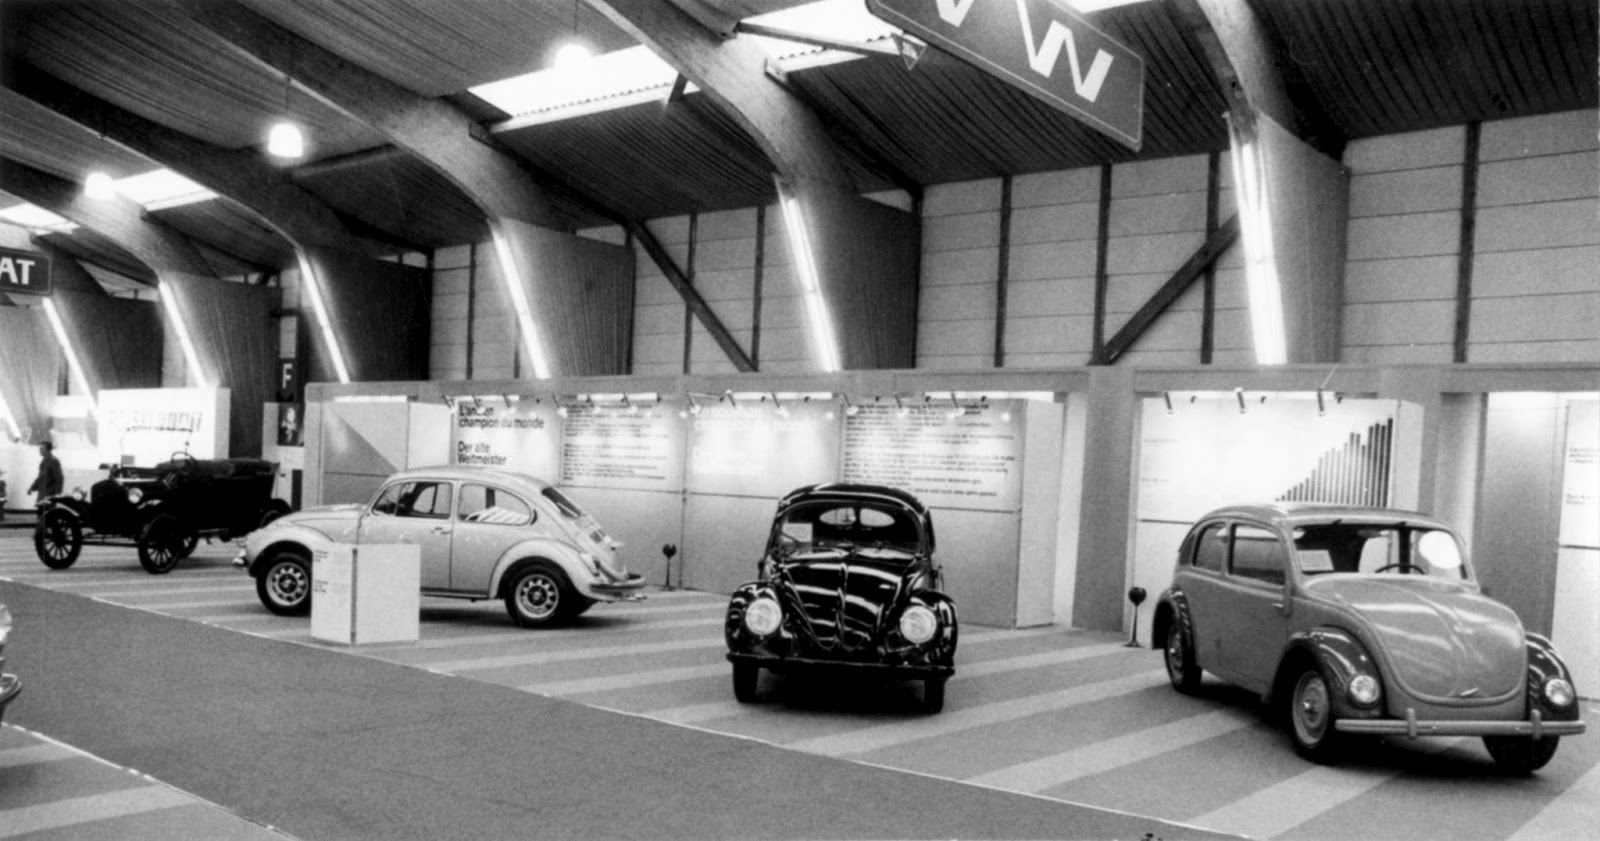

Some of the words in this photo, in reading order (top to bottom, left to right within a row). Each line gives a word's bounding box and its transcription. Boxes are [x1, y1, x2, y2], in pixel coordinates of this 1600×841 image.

[0, 256, 36, 285] AT
[282, 363, 293, 390] F
[460, 404, 494, 416] L'anen
[459, 417, 499, 429] champion
[501, 417, 512, 428] du
[514, 417, 544, 429] monde
[458, 441, 472, 452] Der
[458, 454, 506, 465] Weltmeister
